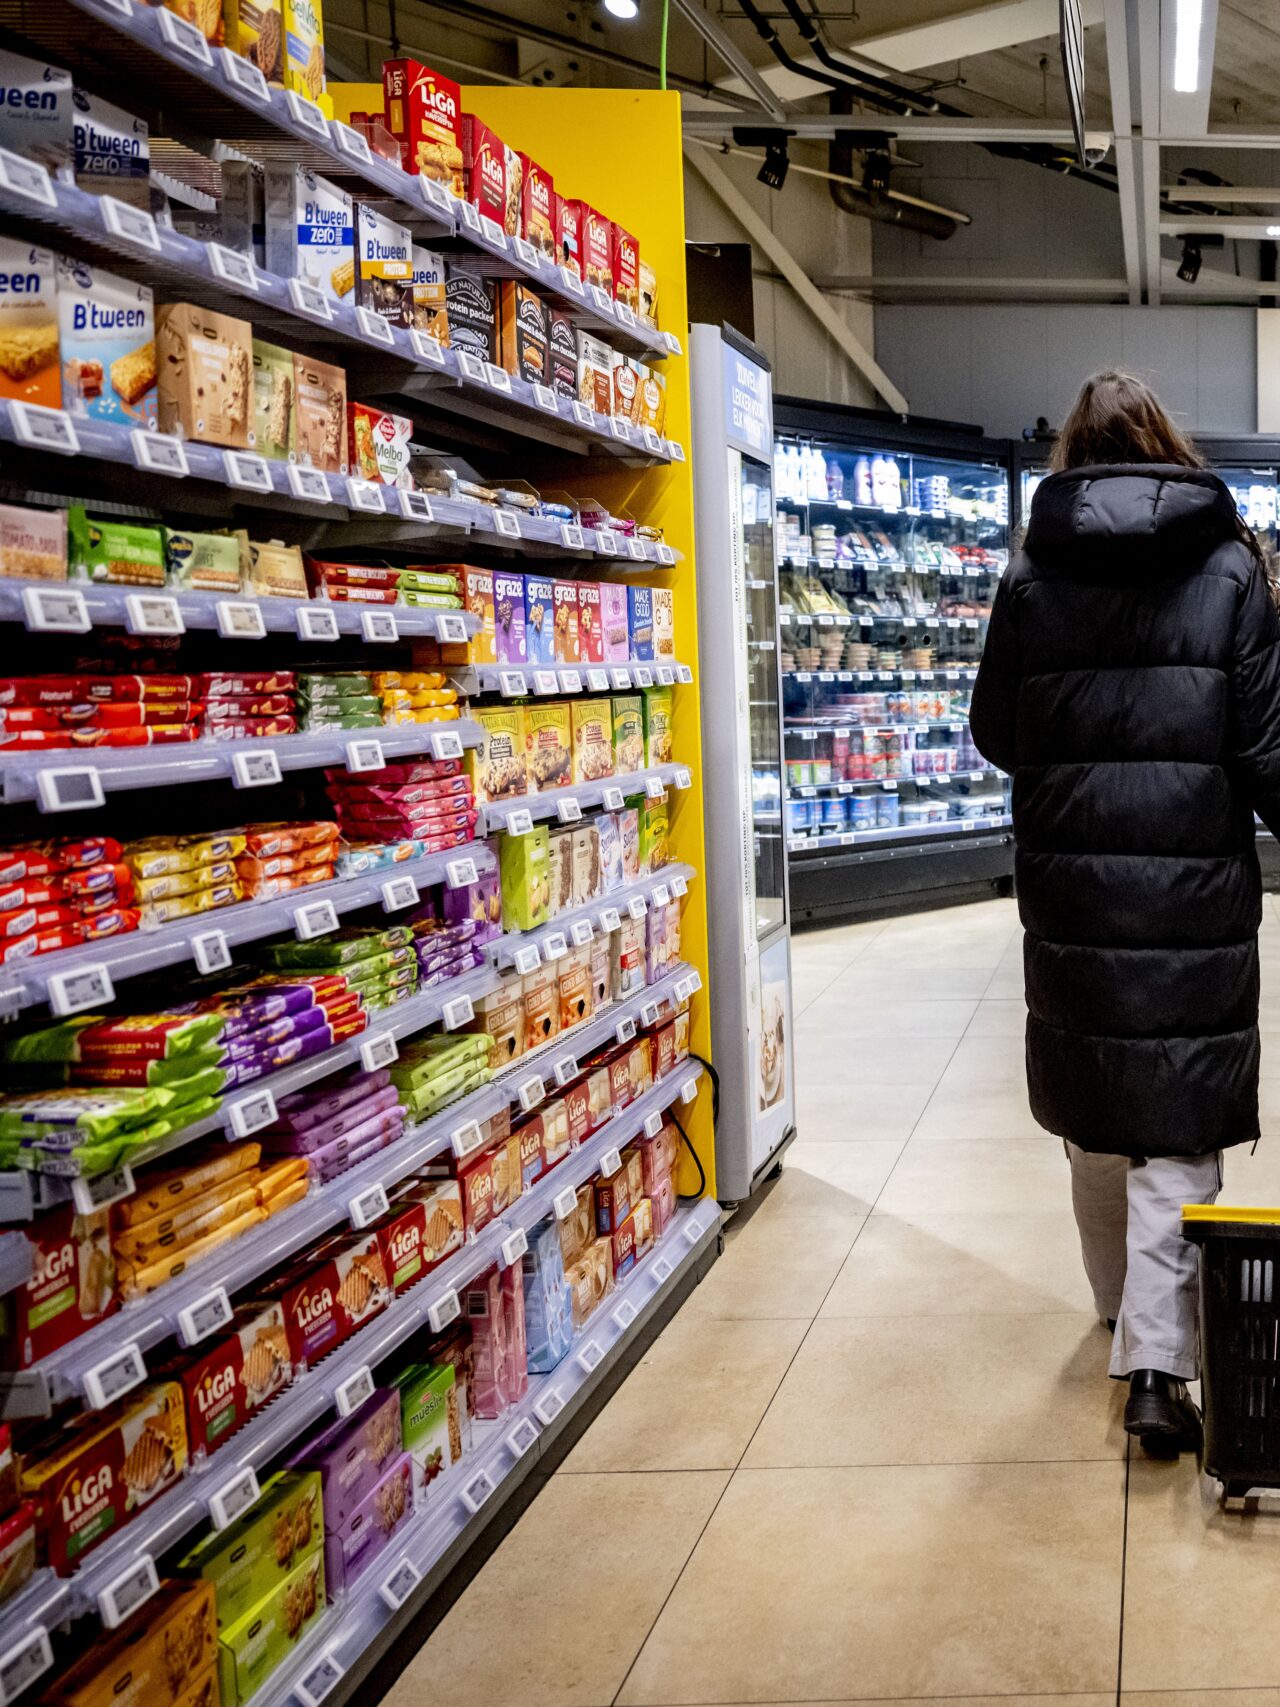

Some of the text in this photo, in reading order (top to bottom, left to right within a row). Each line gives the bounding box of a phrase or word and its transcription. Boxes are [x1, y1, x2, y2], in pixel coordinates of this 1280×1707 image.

[421, 83, 456, 118] LiGA
[74, 124, 140, 157] B'tween
[83, 155, 120, 175] zero
[482, 150, 503, 185] LiGA
[531, 175, 549, 206] LiGA
[304, 201, 348, 228] B'tween
[310, 226, 335, 245] zero
[589, 220, 607, 248] LiGA
[367, 239, 408, 261] B'tween
[621, 241, 636, 266] LiGA
[73, 300, 145, 331] B'tween
[447, 301, 494, 323] rotein packed
[375, 442, 403, 462] Melba
[467, 574, 493, 598] graze
[495, 578, 523, 600] graze
[528, 582, 553, 602] graze
[555, 585, 576, 605] graze
[579, 588, 599, 607] graze
[635, 590, 649, 603] MADE
[635, 603, 650, 617] GOOD
[655, 592, 672, 608] MADE
[489, 736, 511, 747] Protein
[613, 1066, 629, 1088] LiGA
[569, 1097, 587, 1122] LiGA
[521, 1131, 540, 1159] LiGA
[470, 1180, 493, 1208] LiGA
[391, 1225, 420, 1258] LiGA
[297, 1287, 333, 1328] LiGA
[198, 1365, 236, 1412] LiGA
[409, 1393, 442, 1427] muesli
[62, 1464, 113, 1522] LiGA
